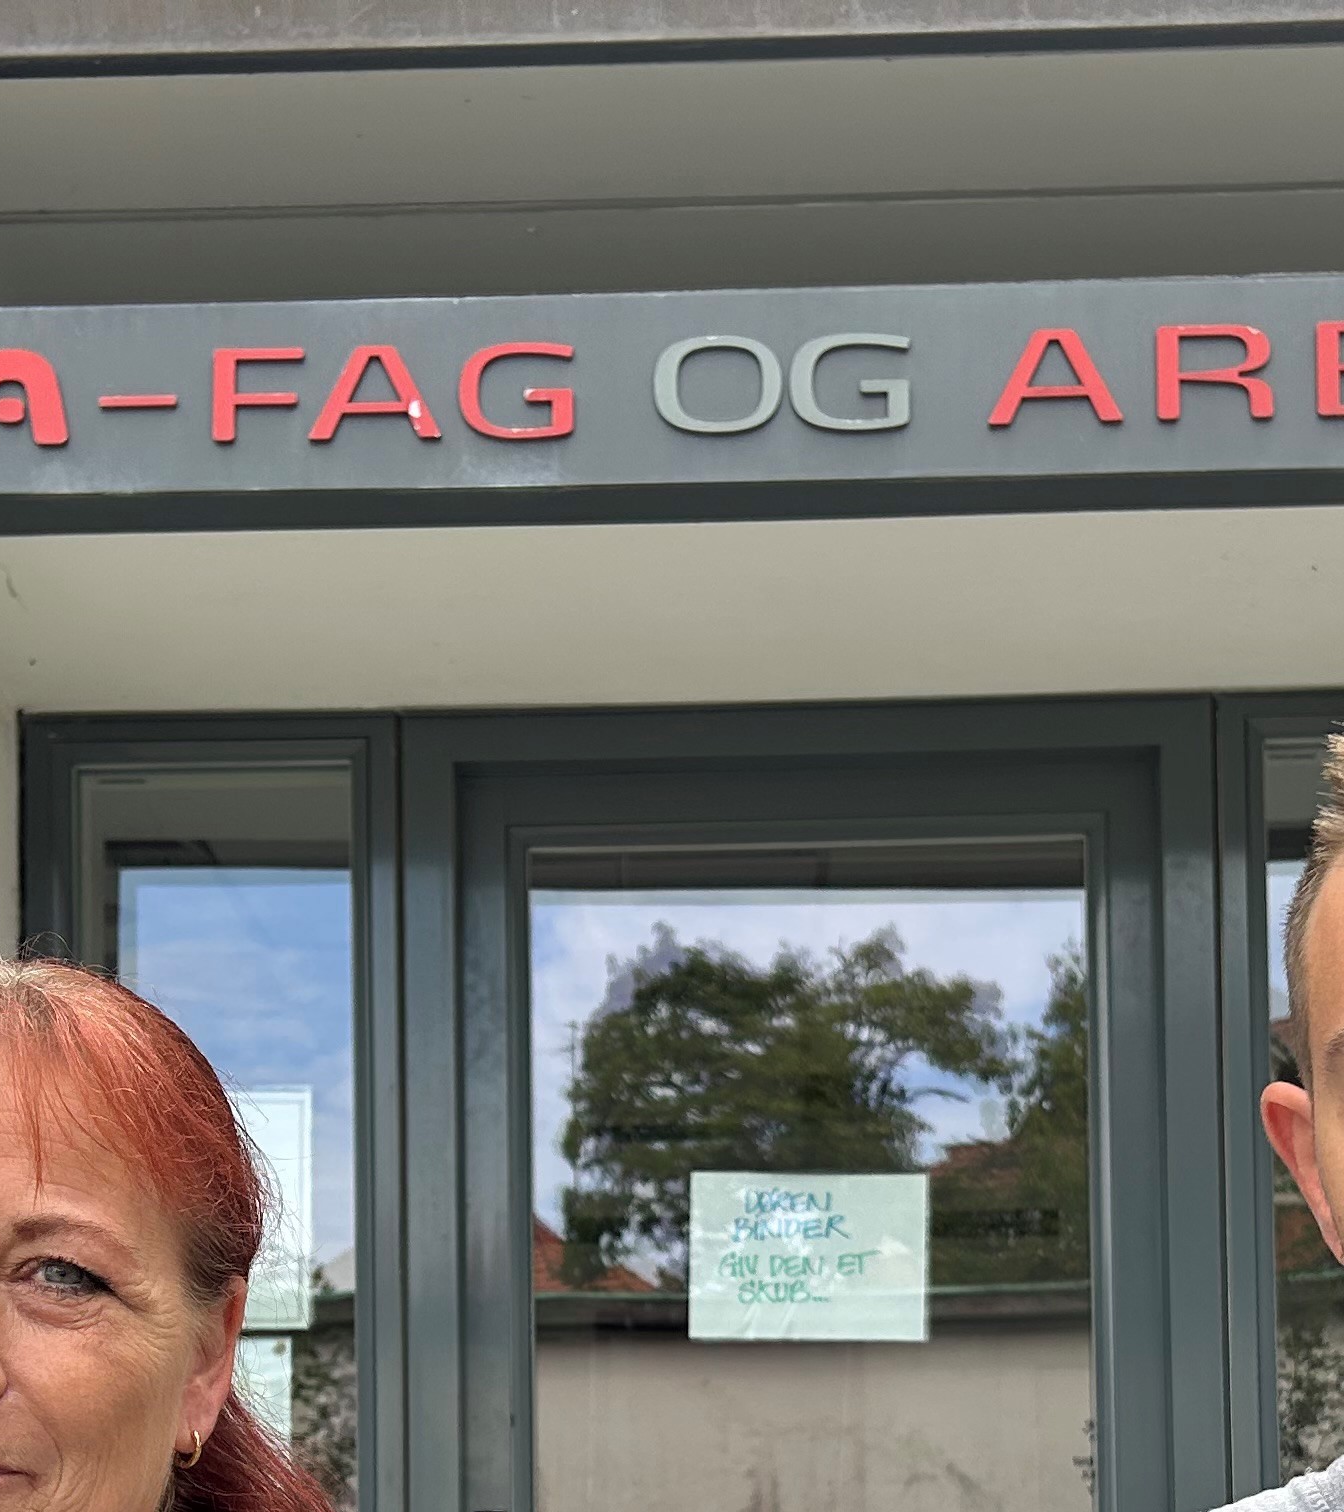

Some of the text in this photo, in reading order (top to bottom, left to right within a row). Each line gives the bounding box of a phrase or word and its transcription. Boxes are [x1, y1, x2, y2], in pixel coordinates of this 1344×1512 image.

[211, 341, 575, 442] FAG
[654, 331, 912, 435] OG
[769, 1254, 825, 1277] DEN
[836, 1249, 882, 1276] ET
